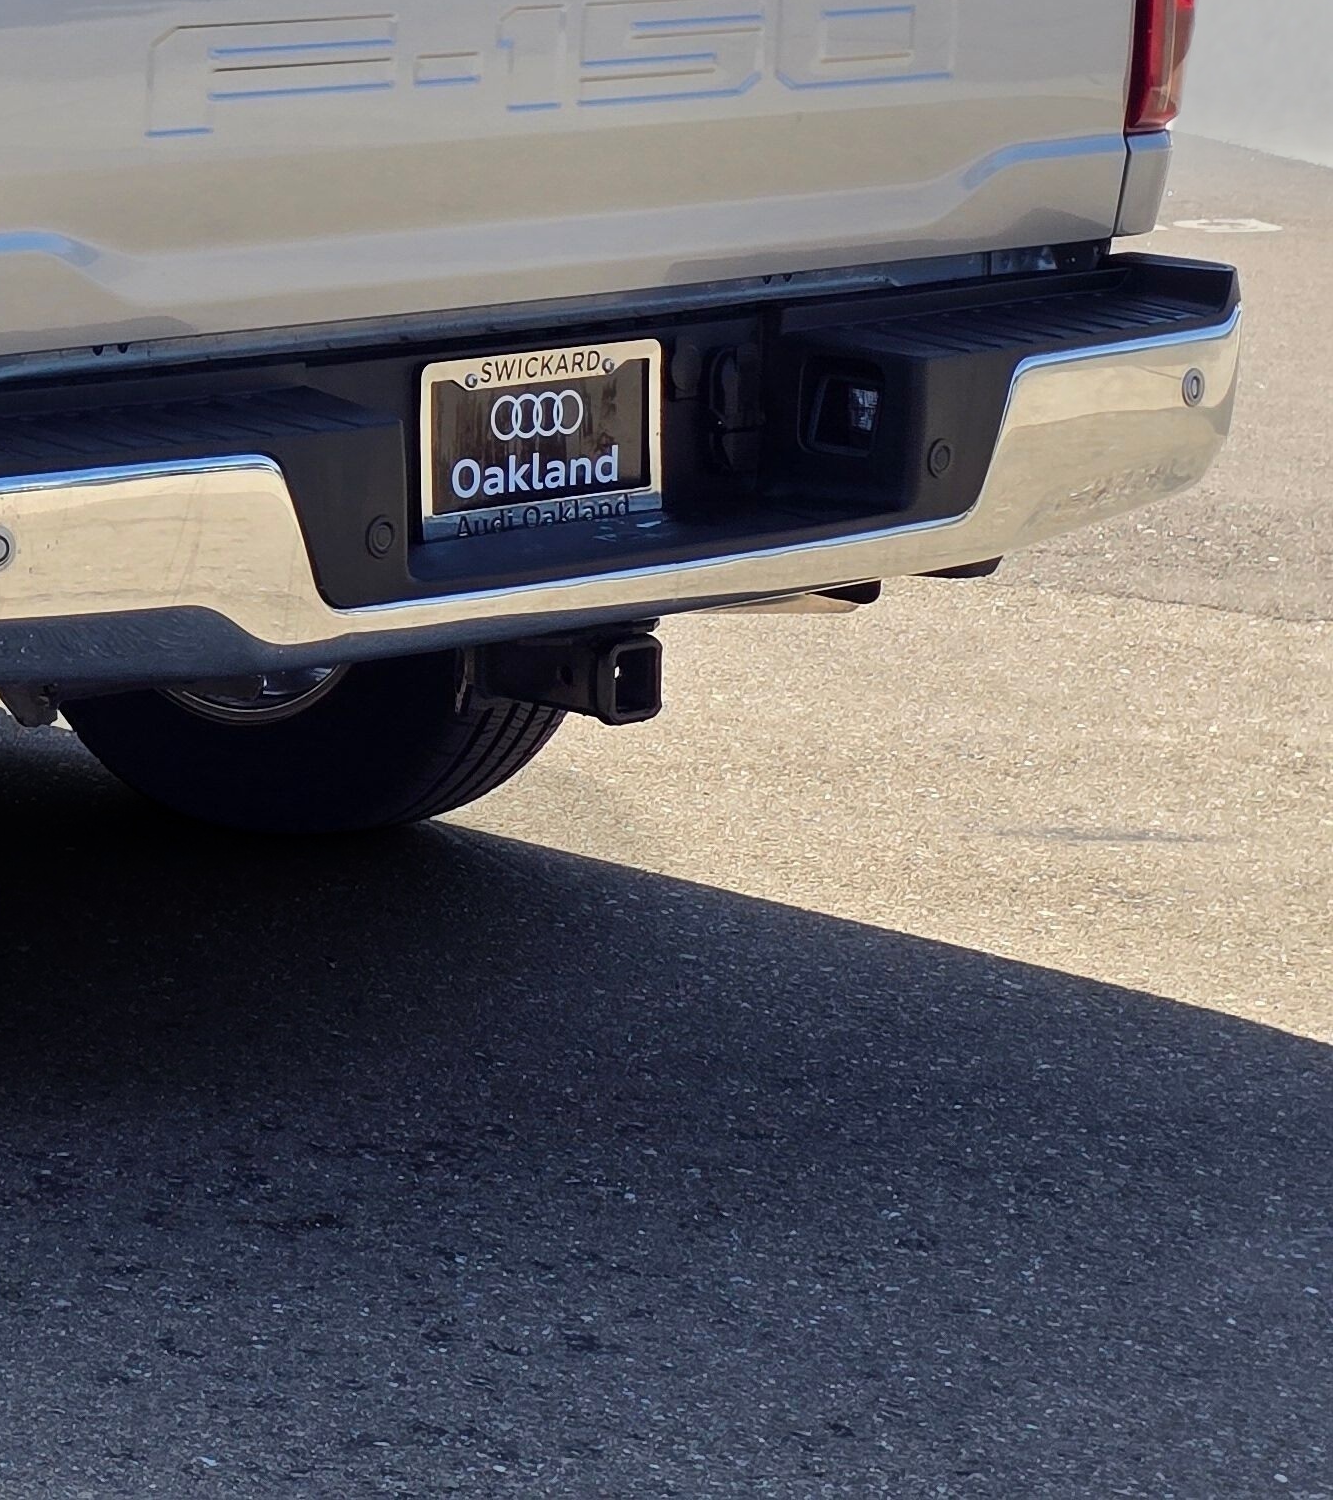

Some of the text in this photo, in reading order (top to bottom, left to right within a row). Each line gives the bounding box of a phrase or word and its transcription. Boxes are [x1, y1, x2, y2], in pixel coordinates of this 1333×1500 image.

[479, 350, 600, 383] SWICKARD
[451, 444, 619, 499] Oakland
[457, 493, 630, 538] Audi Oakland
